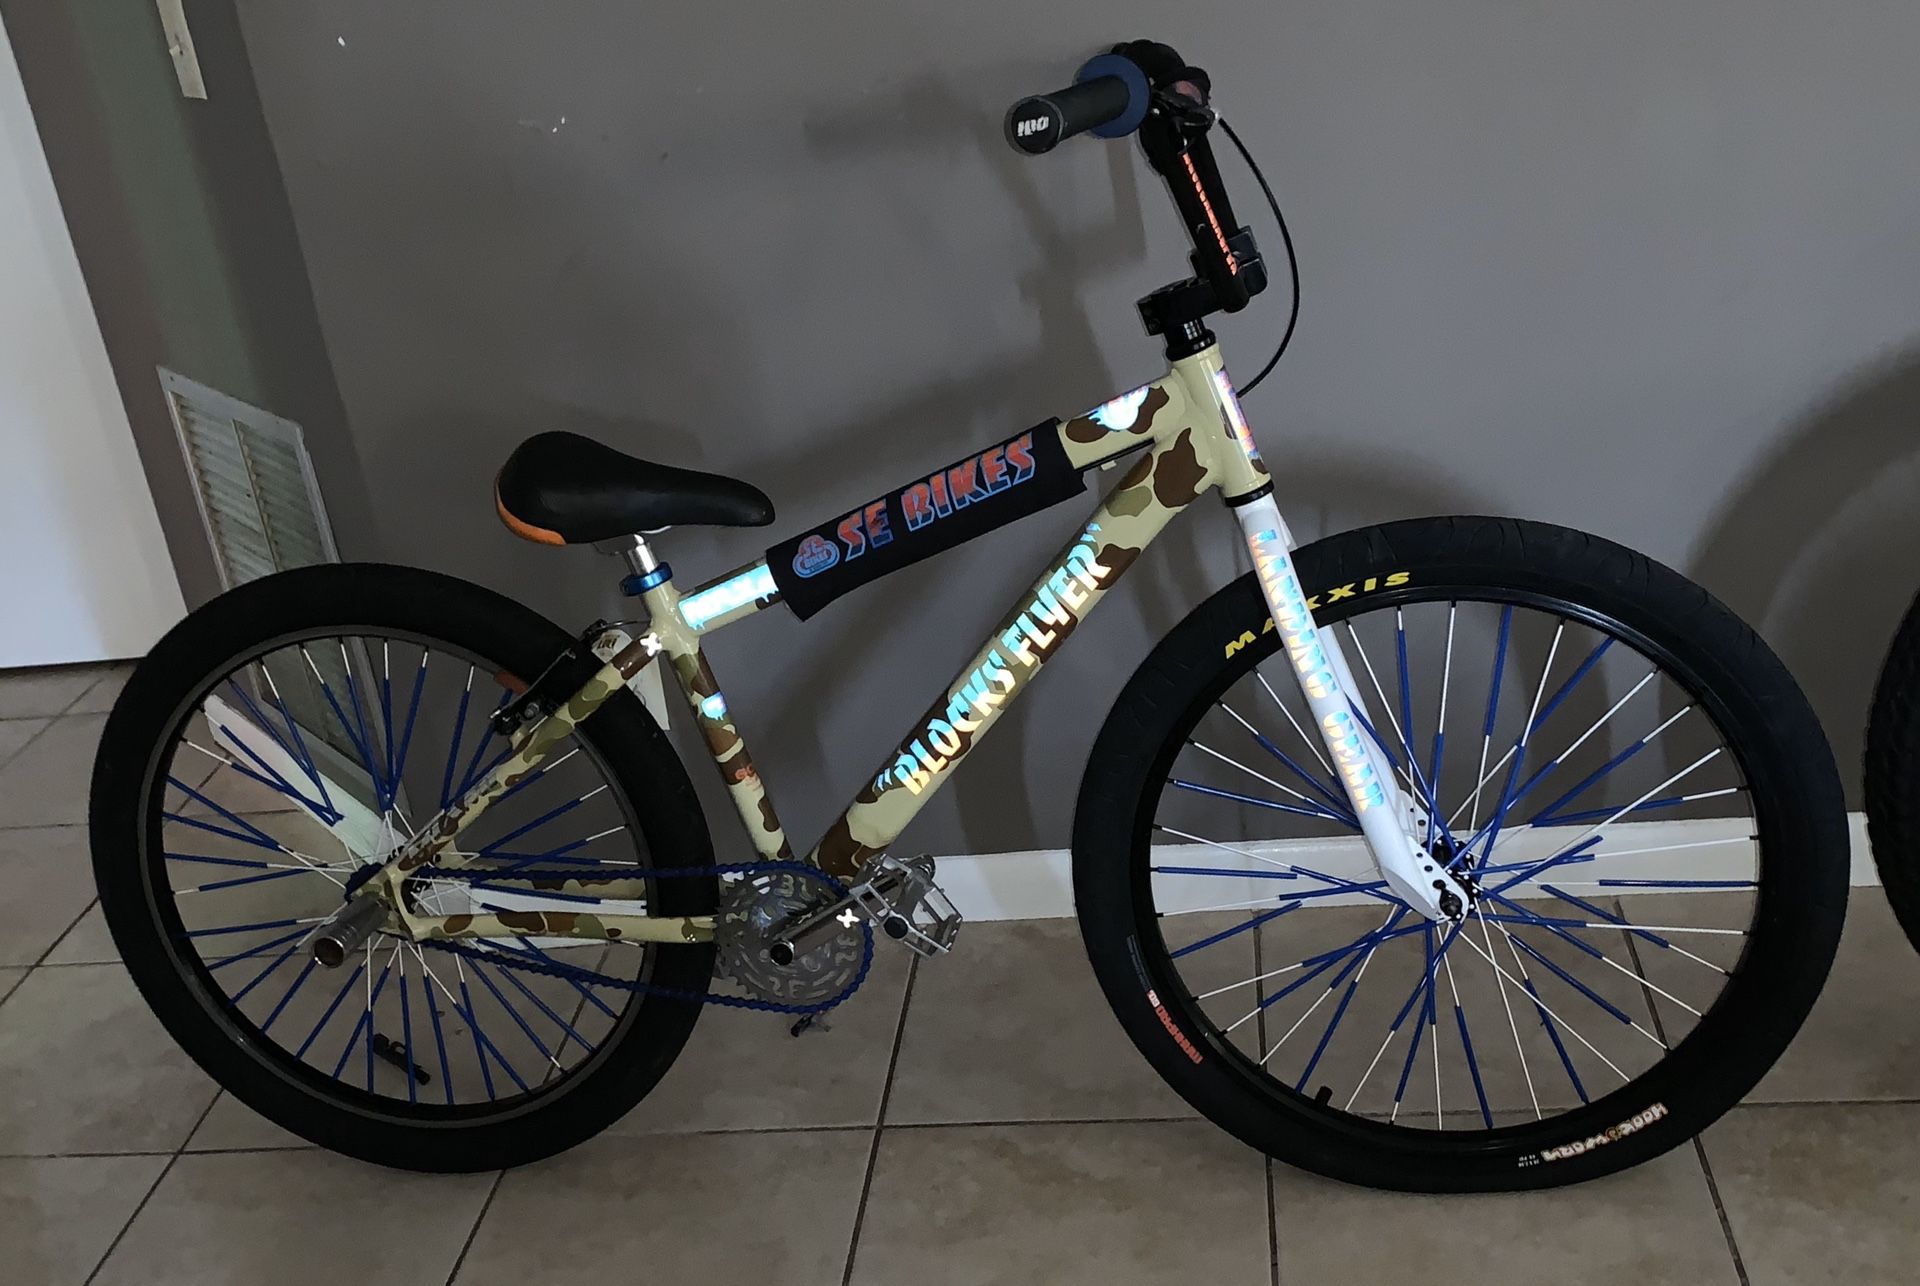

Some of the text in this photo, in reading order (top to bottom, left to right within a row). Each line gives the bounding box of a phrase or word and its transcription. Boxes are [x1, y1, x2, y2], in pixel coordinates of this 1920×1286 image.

[837, 431, 1036, 562] SE BIKES
[1250, 528, 1385, 812] LANDING GEAR
